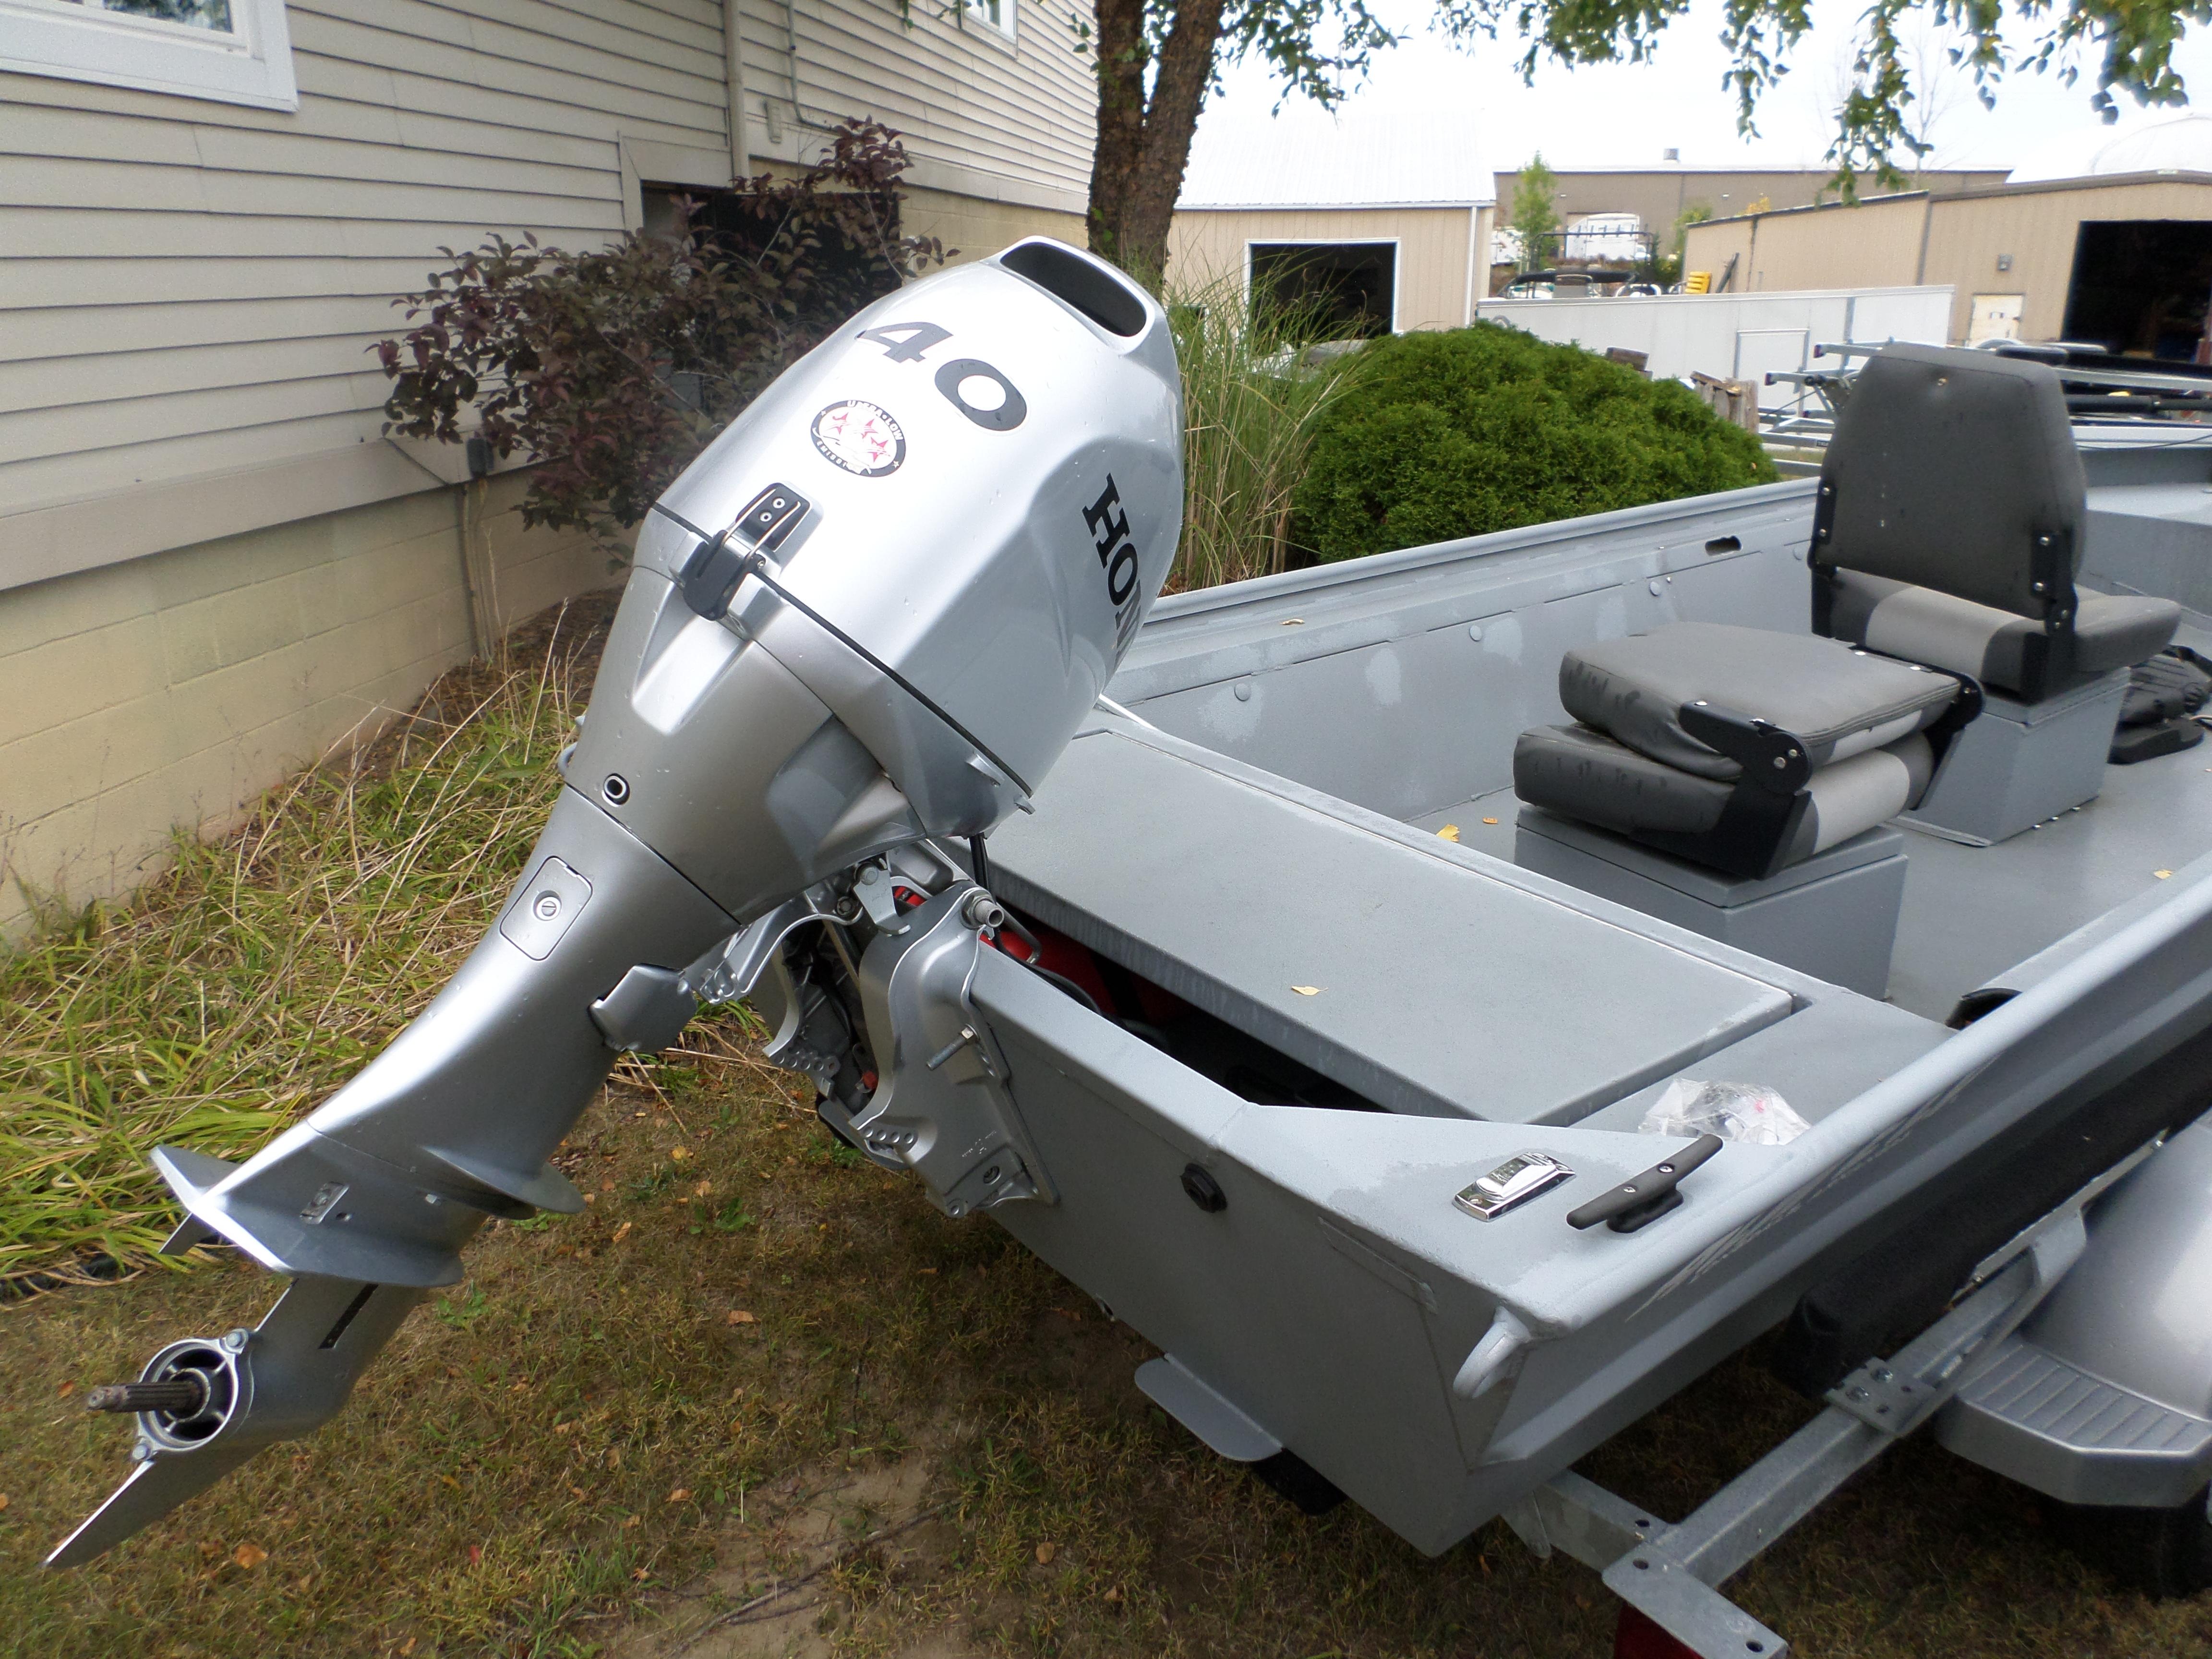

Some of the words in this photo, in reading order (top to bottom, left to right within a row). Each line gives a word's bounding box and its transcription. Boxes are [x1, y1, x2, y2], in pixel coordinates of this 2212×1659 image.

[856, 322, 1027, 432] 40
[885, 418, 903, 440] LOW
[816, 441, 862, 474] EMISSI
